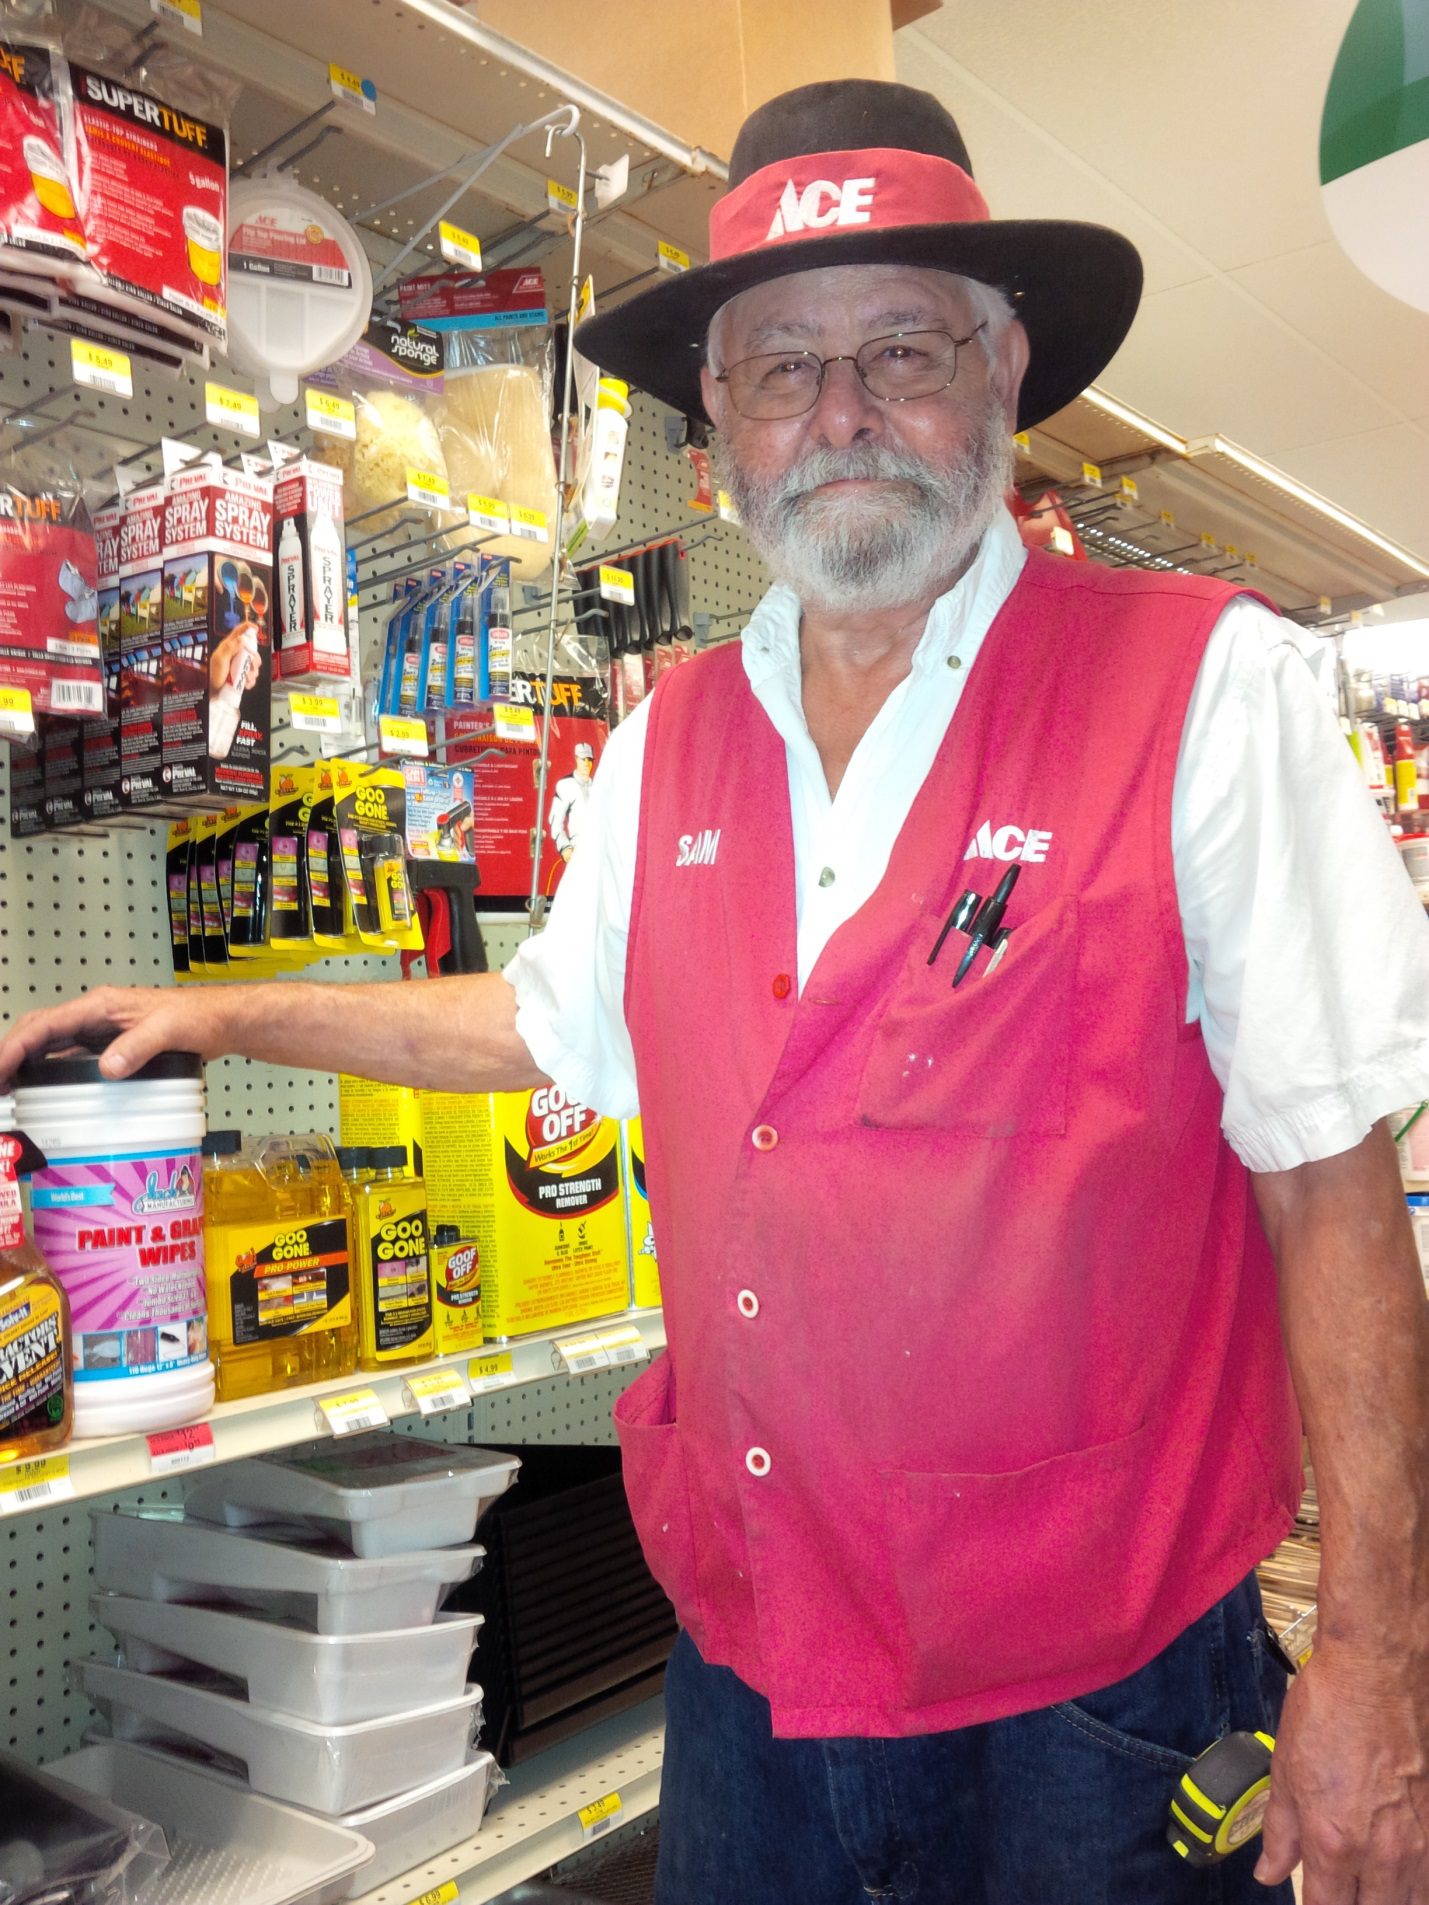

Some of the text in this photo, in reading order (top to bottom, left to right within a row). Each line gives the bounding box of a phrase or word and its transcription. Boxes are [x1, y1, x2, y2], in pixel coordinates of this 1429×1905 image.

[86, 75, 207, 148] SUPERTUFF
[765, 177, 877, 241] ACE
[391, 335, 439, 357] natural
[392, 344, 437, 367] sponge
[165, 497, 209, 530] SPRAY
[215, 498, 271, 535] SPRAY
[120, 516, 161, 547] SPRAY
[165, 520, 207, 544] SYSTEM
[215, 519, 269, 549] SYSTEM
[120, 539, 161, 562] SYSTEM
[287, 564, 297, 632] SPRAYER
[322, 556, 334, 624] SPRAYER
[355, 787, 385, 804] GOO
[355, 800, 388, 820] GONE
[676, 828, 721, 867] SAM
[963, 820, 1053, 863] ACE
[542, 1105, 587, 1142] OFF
[534, 1150, 556, 1163] Works
[538, 1178, 602, 1199] PRO STRENGTH
[556, 1194, 588, 1209] REMOVER
[78, 1225, 146, 1250] PAINT
[150, 1226, 165, 1243] &
[274, 1229, 308, 1247] GOO
[380, 1219, 423, 1241] GOO
[138, 1241, 196, 1268] WIPES
[272, 1243, 310, 1261] GONE
[377, 1238, 426, 1260] GONE
[448, 1247, 477, 1270] GOOF
[452, 1262, 473, 1279] OFF
